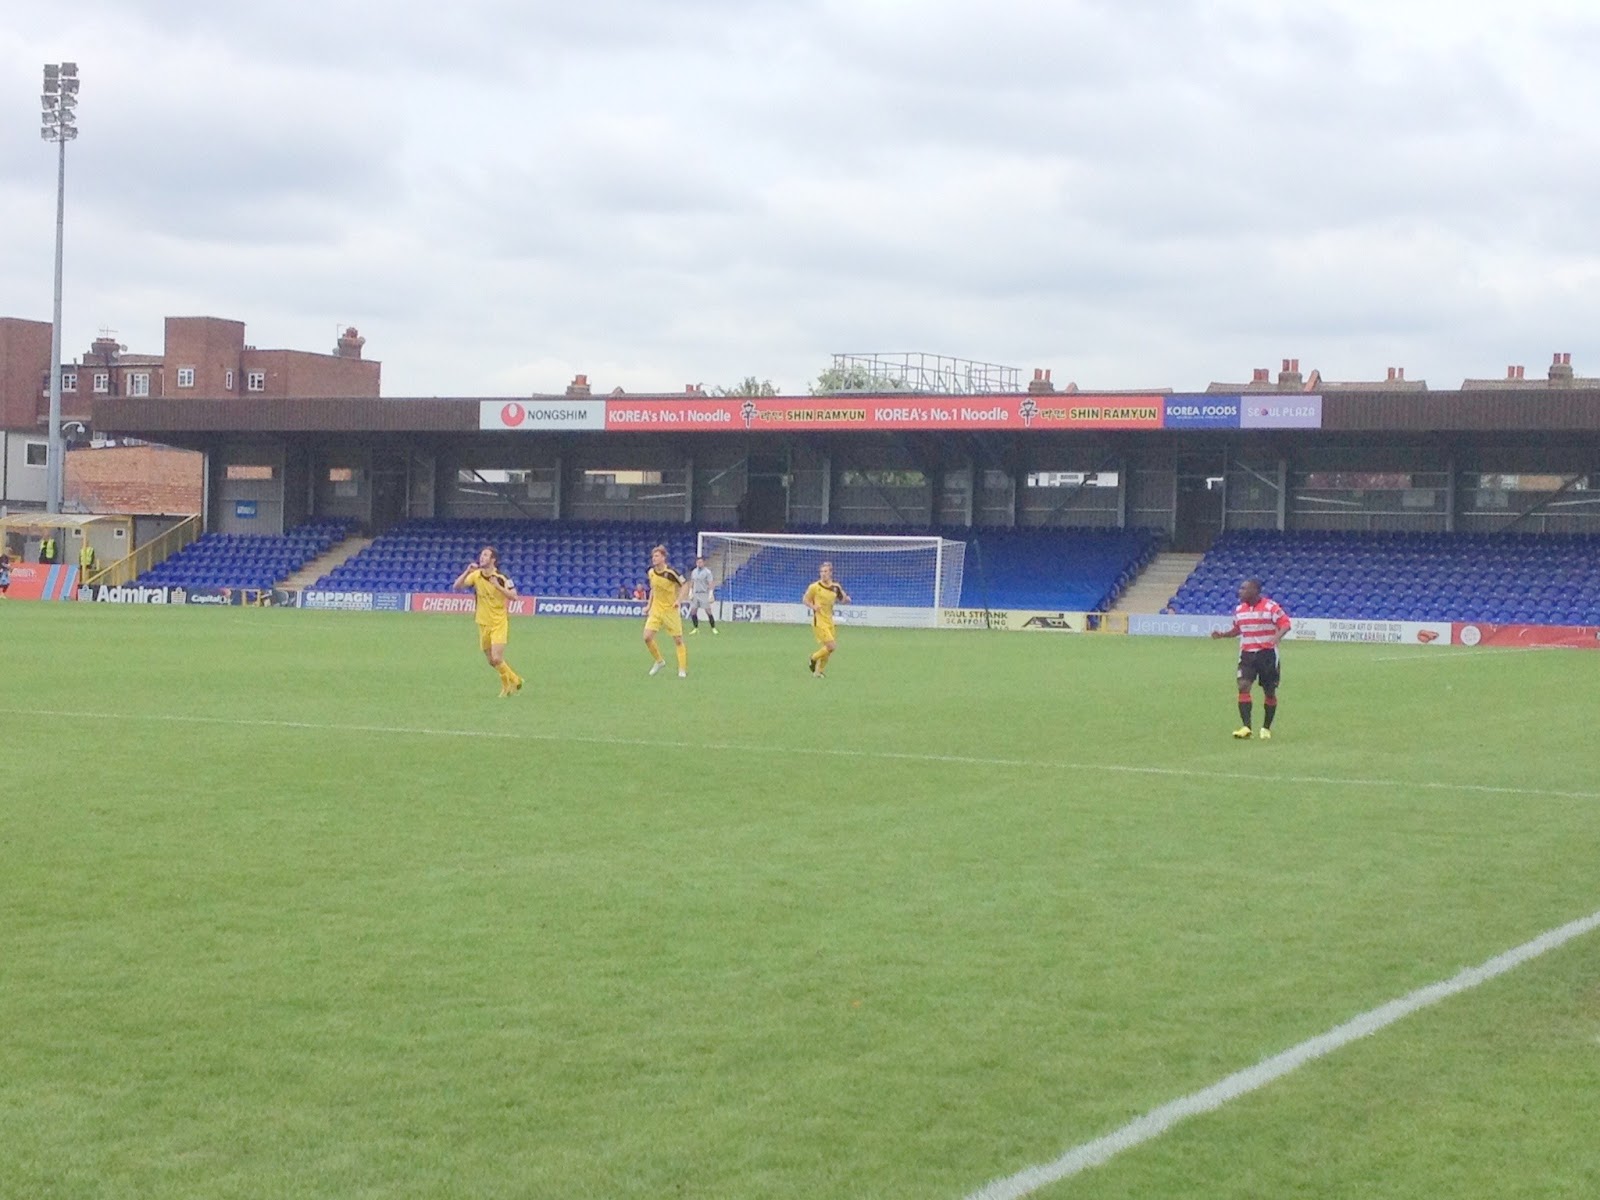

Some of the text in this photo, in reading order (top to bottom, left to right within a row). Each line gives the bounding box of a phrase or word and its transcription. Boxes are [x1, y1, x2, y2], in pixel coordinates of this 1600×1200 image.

[527, 409, 588, 421] NONGSHIM
[608, 408, 732, 423] KOREA's No.1 Noodle
[787, 409, 866, 421] SHIN RAMYUN
[874, 406, 1009, 421] KOREA's No.1 Noodle
[1069, 407, 1158, 420] SHIN RAMYUN
[1166, 405, 1237, 416] KOREA FOODS
[1282, 406, 1316, 417] PLAZA
[97, 584, 168, 605] Admiral
[306, 591, 374, 603] CAPPAGH
[538, 602, 595, 615] FOOTBALL
[734, 604, 758, 622] sky
[944, 610, 968, 618] PAUL
[1133, 618, 1186, 633] Jenner
